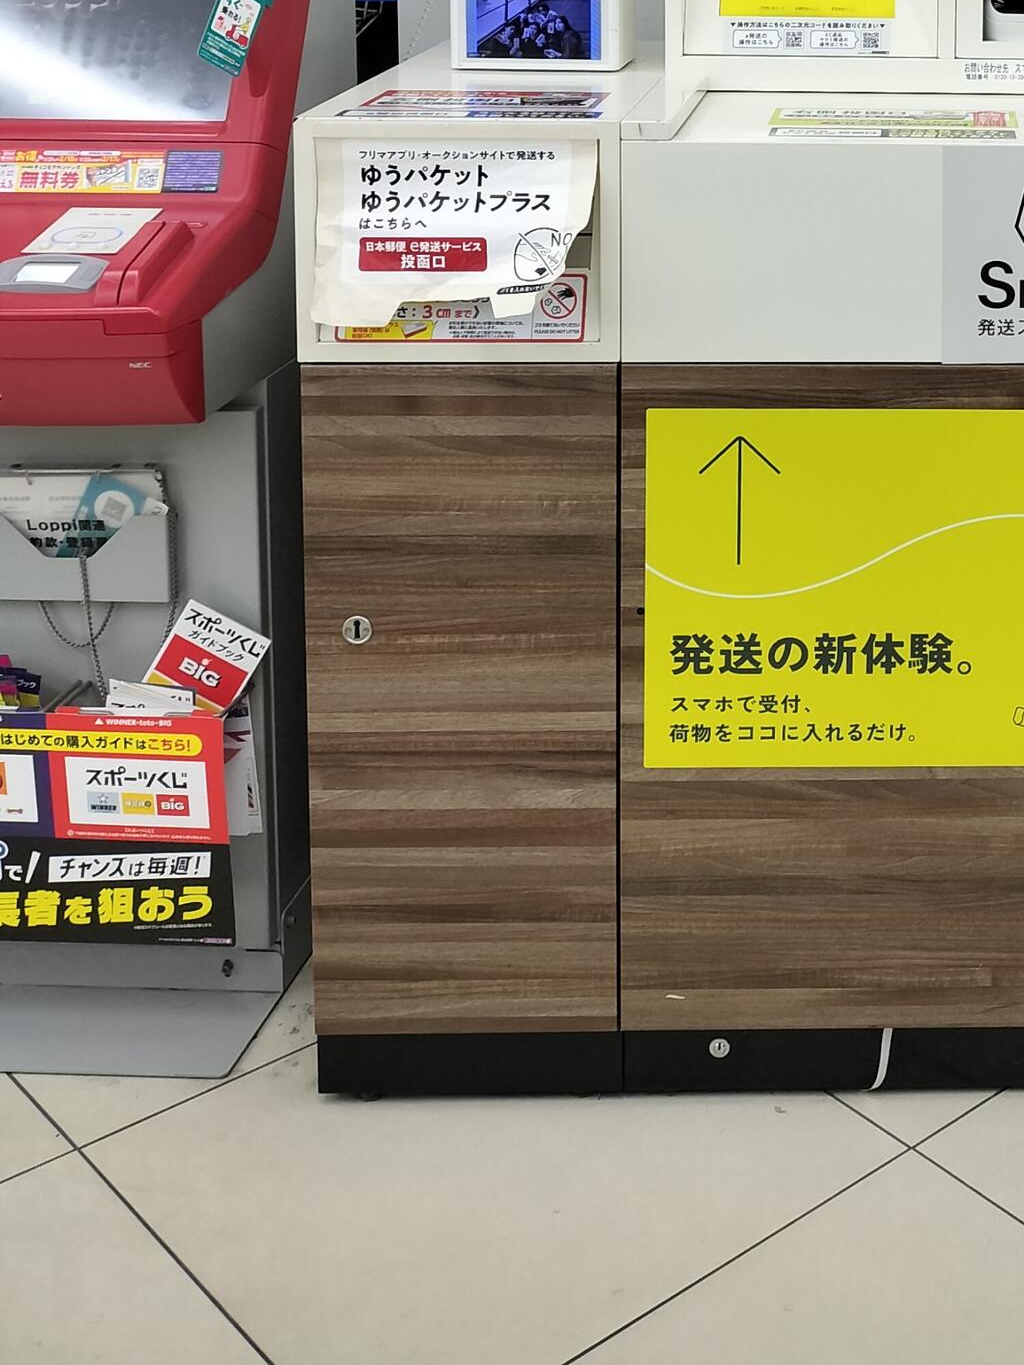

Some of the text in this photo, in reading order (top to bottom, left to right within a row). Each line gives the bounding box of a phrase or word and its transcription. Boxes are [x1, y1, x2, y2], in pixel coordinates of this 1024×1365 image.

[964, 63, 1008, 74] お問い合わせ先
[358, 150, 556, 161] フリマアプリ・オークションサイトで発送する
[20, 171, 80, 188] 無料券
[360, 164, 489, 187] ゆうパケット
[360, 190, 551, 213] ゆうパケットプラス
[358, 217, 428, 230] はこちらへ
[365, 241, 406, 252] 日本郵便
[551, 232, 572, 248] NO
[400, 254, 446, 270] 投函口
[129, 361, 152, 369] NEC
[184, 607, 266, 658] スポーツくじ
[188, 629, 244, 662] ガイドブック
[669, 632, 972, 676] 発送の新体験。
[177, 657, 221, 688] BIG
[670, 694, 812, 714] スマホで受付、
[669, 723, 917, 743] 荷物をココに入れるだけ。
[86, 766, 188, 789] スポーツくじ
[90, 803, 117, 812] WINNER
[161, 798, 185, 810] BIG
[59, 856, 202, 879] チャンスは毎週!
